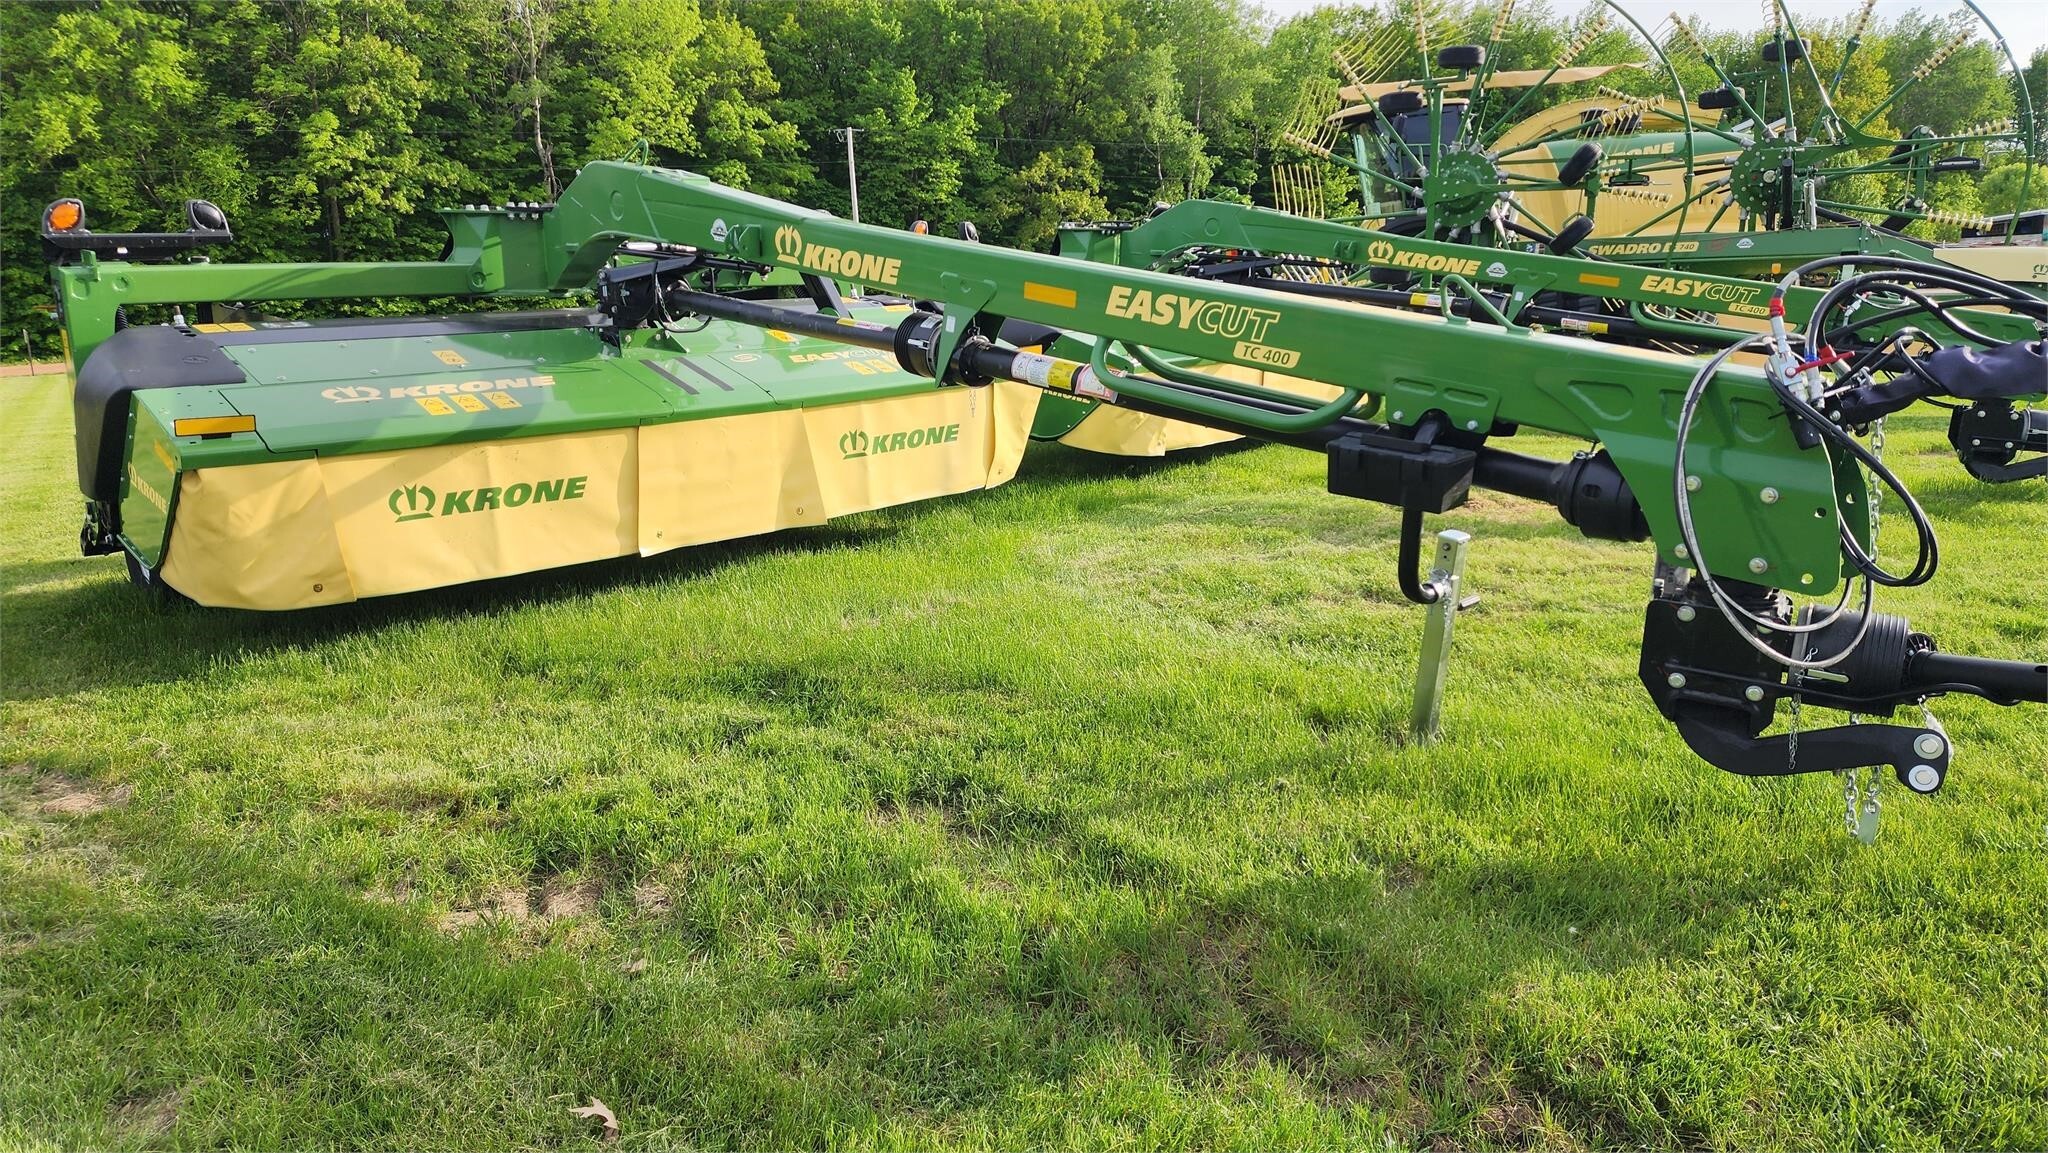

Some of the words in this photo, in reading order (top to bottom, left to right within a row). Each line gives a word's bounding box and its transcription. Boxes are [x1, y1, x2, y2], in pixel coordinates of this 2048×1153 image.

[803, 243, 902, 285] KRONE
[1392, 251, 1482, 276] KRONE
[1588, 243, 1661, 256] SWADRO
[1640, 275, 1761, 304] EASYCUT
[1105, 285, 1281, 343] EASYCUT
[1734, 304, 1747, 312] TC
[1747, 306, 1766, 315] 400
[1242, 345, 1258, 360] TC
[1262, 348, 1291, 366] 400
[390, 376, 556, 398] KRONE
[872, 423, 960, 455] KRONE
[137, 475, 167, 515] KRONE
[441, 476, 588, 516] KRONE
